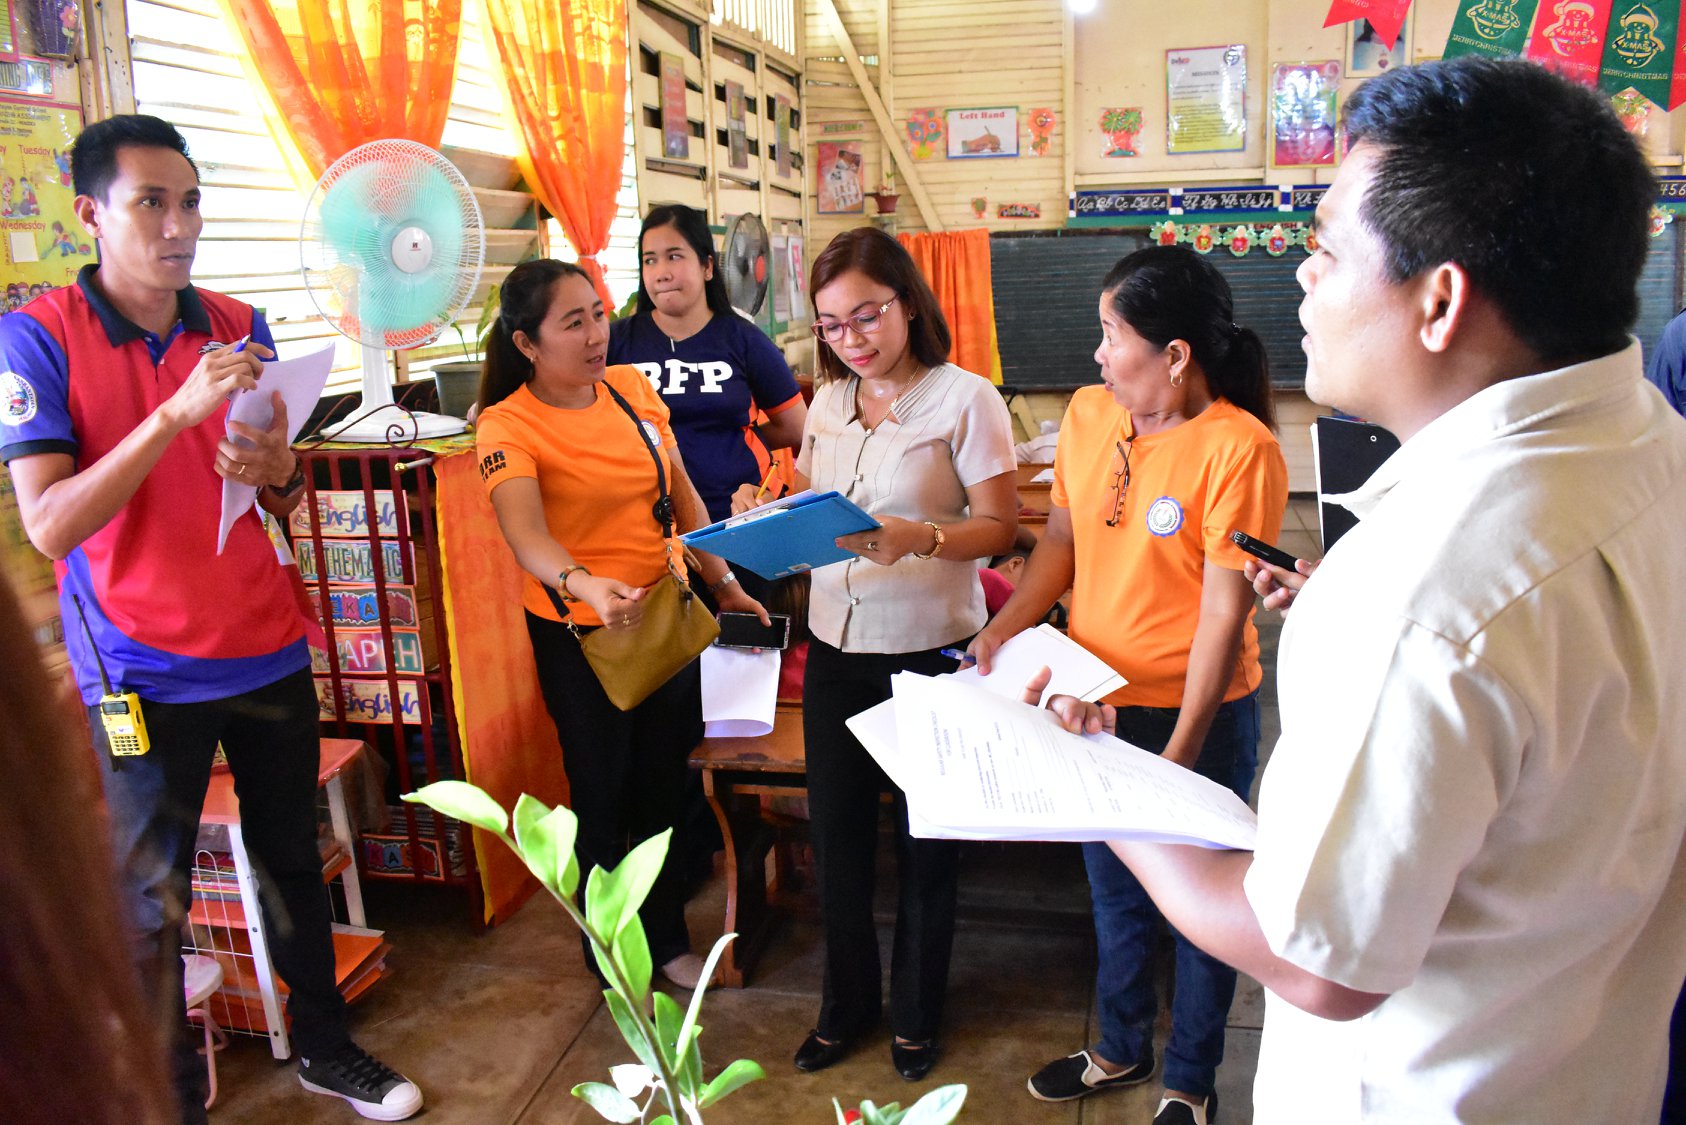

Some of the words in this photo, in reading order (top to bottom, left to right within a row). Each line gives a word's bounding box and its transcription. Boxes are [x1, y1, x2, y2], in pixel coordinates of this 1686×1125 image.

[960, 112, 978, 120] Left
[981, 111, 1005, 119] Hand
[18, 144, 51, 157] Tuesday
[0, 220, 46, 232] Wednesday
[632, 358, 733, 395] BFP
